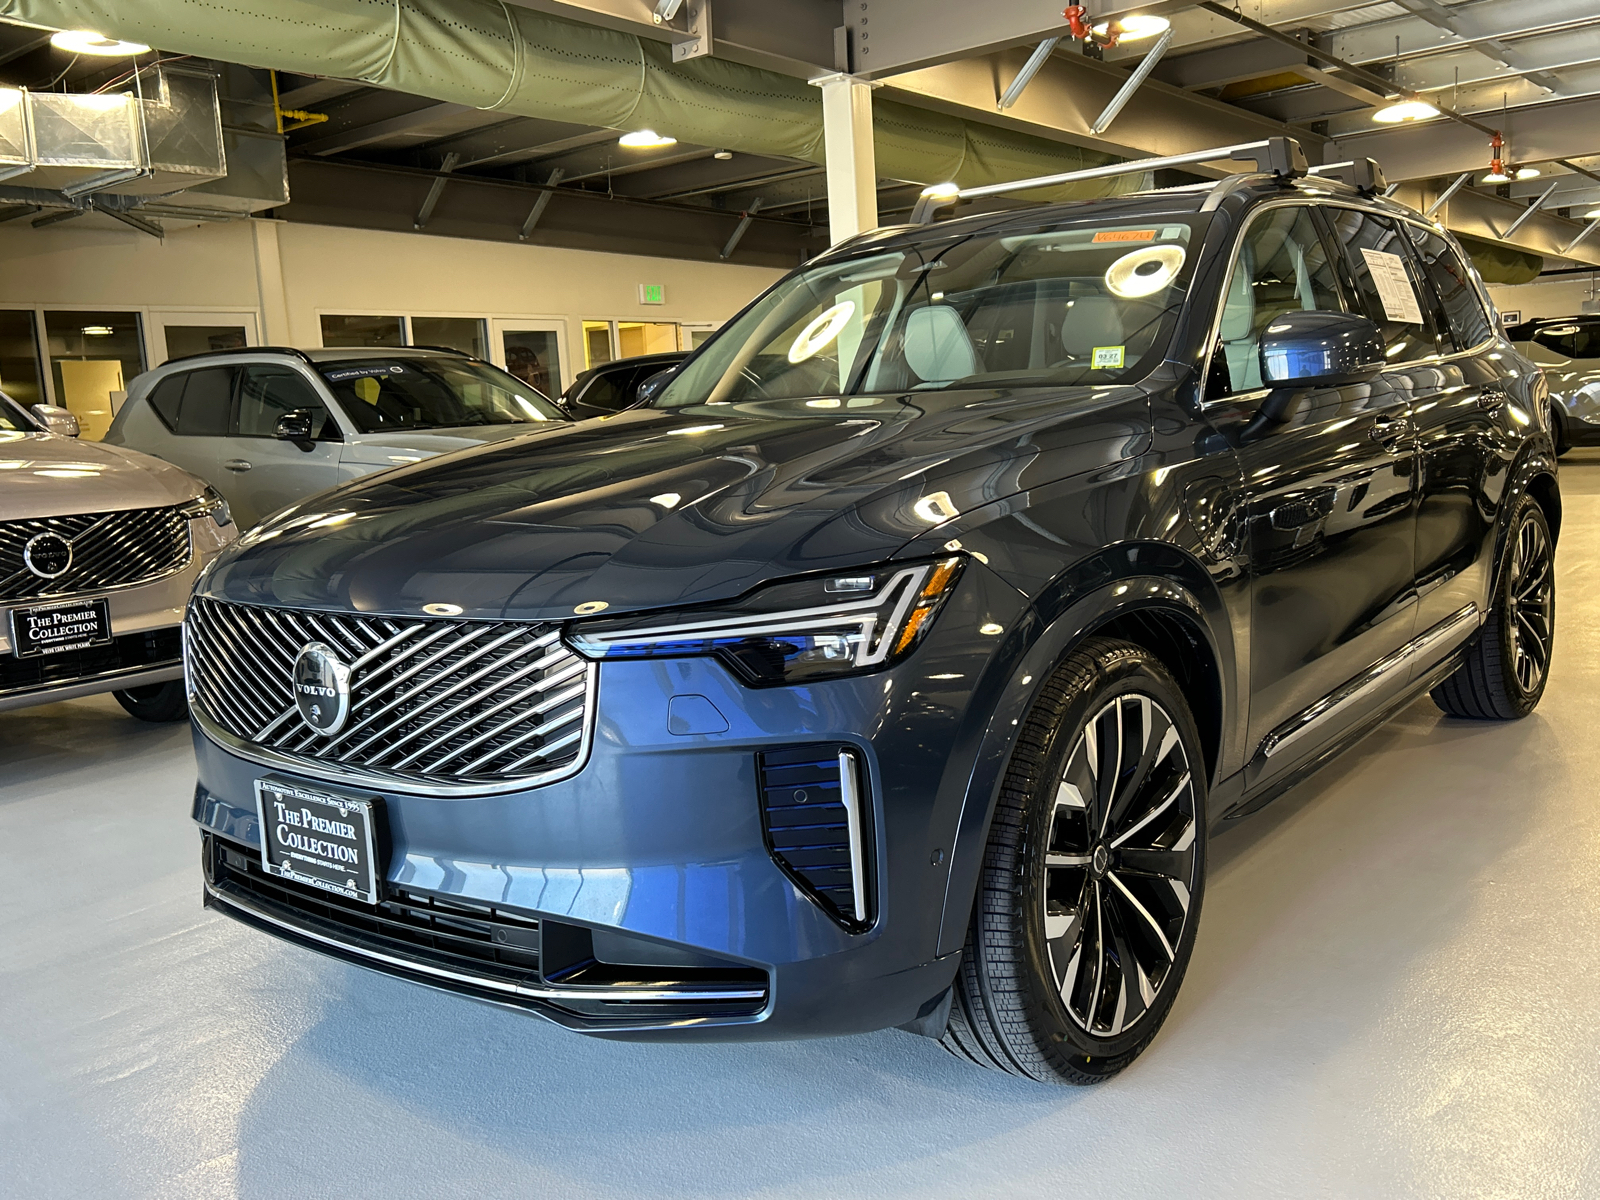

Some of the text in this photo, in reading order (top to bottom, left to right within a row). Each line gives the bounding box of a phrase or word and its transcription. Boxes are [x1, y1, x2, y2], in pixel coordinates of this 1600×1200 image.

[332, 370, 360, 378] Certified
[26, 610, 97, 628] THE PREMIER
[29, 621, 98, 640] COLLECTION
[296, 683, 336, 697] VOLVO
[262, 782, 360, 812] AUTOMOTIVE EXCELLENCE SINCE 1995
[273, 801, 357, 840] THE PREMIER
[276, 824, 358, 865] COLLECTION
[290, 851, 317, 865] EVERYTHING
